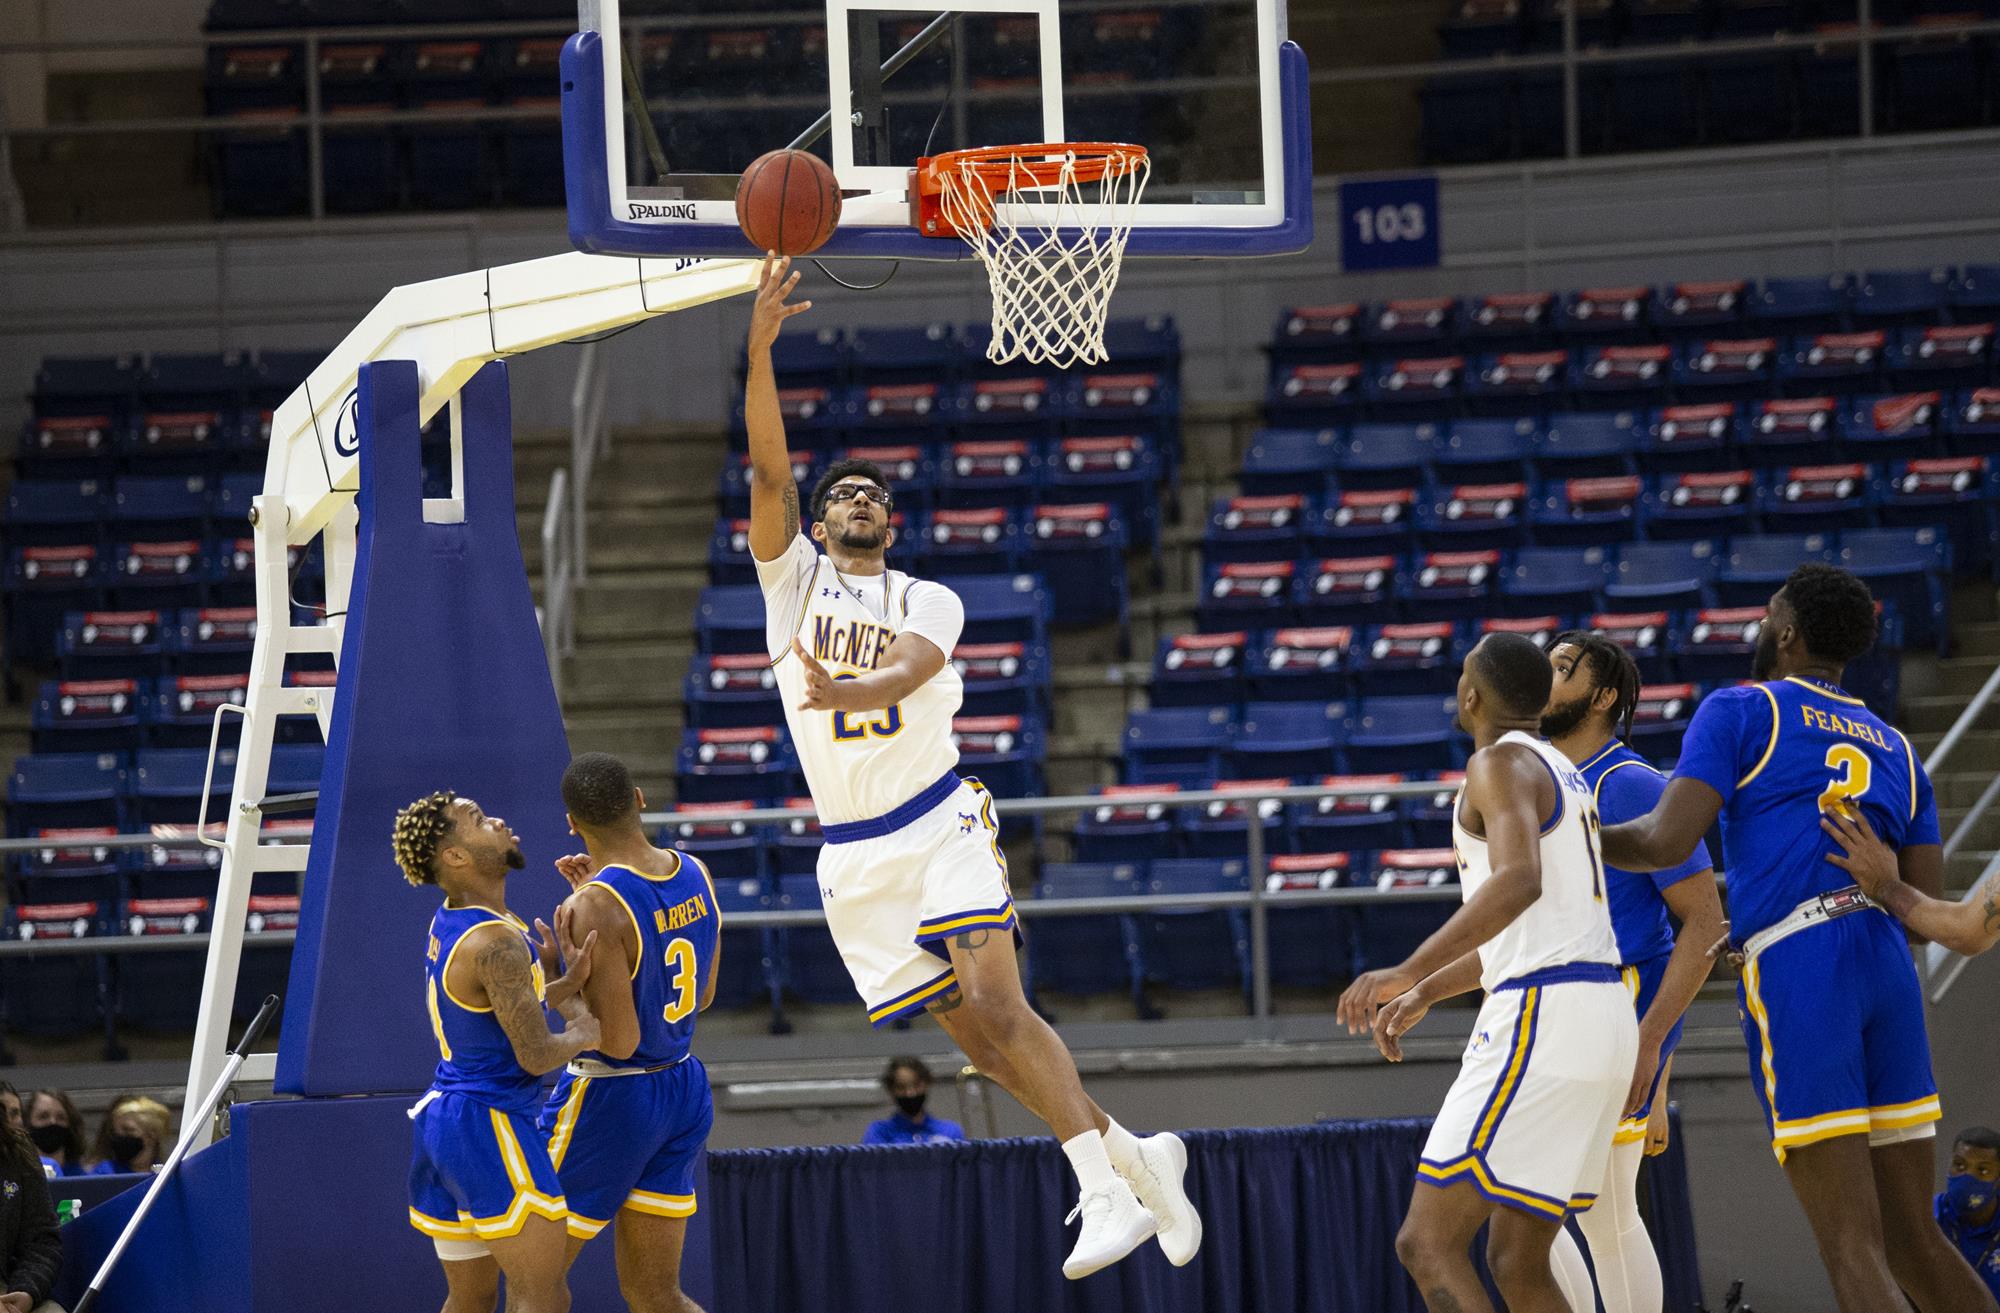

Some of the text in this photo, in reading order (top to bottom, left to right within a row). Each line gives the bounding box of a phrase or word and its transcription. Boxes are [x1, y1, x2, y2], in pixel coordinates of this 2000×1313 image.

[628, 203, 697, 220] SPALDING
[1353, 203, 1425, 244] 103
[813, 614, 897, 670] McNEE
[1801, 705, 1892, 751] FEAZELL
[1818, 743, 1871, 822] 2
[663, 937, 697, 1024] 3
